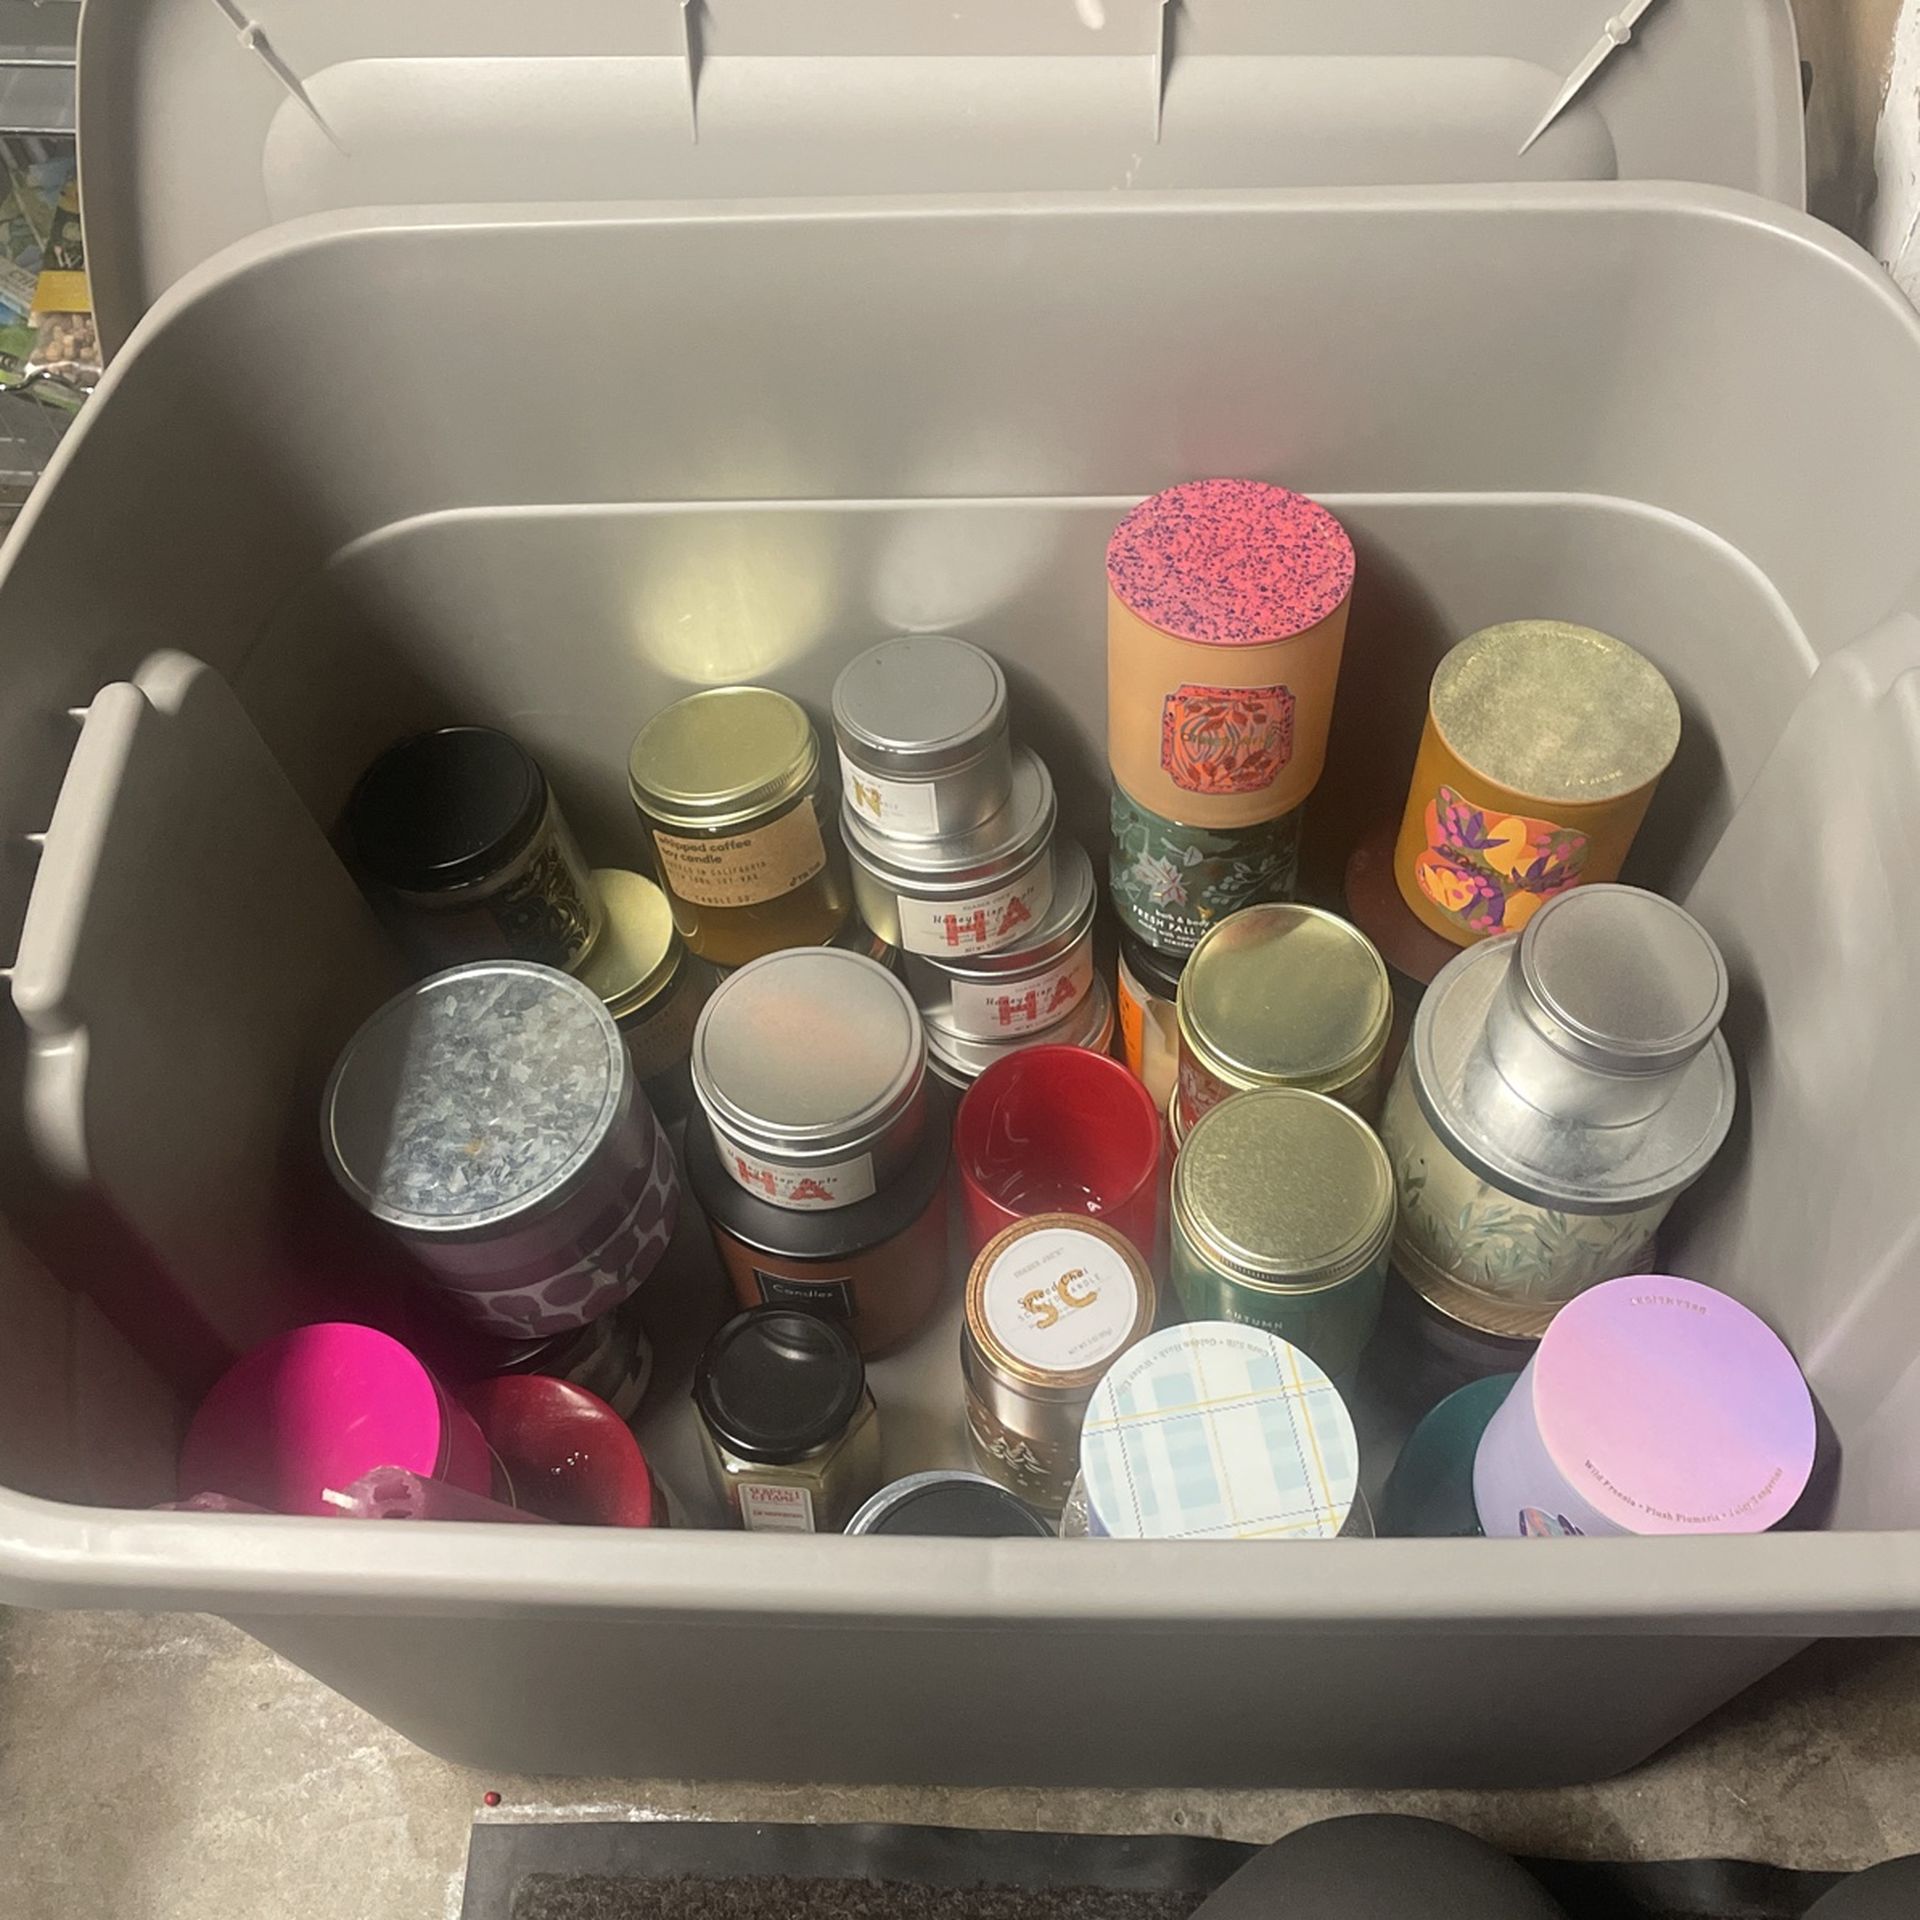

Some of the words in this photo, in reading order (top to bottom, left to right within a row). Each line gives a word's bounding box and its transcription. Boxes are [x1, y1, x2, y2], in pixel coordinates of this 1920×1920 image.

[852, 775, 882, 818] N
[658, 836, 707, 853] whipped
[709, 838, 752, 852] coffee
[680, 851, 722, 864] candle
[1132, 904, 1164, 928] FRESH
[1168, 922, 1195, 936] FALL
[1186, 918, 1210, 929] body
[772, 1283, 834, 1299] Candles
[1225, 1308, 1283, 1330] AUTUMN
[1584, 1458, 1604, 1482] Wild
[1645, 1506, 1675, 1522] Plush
